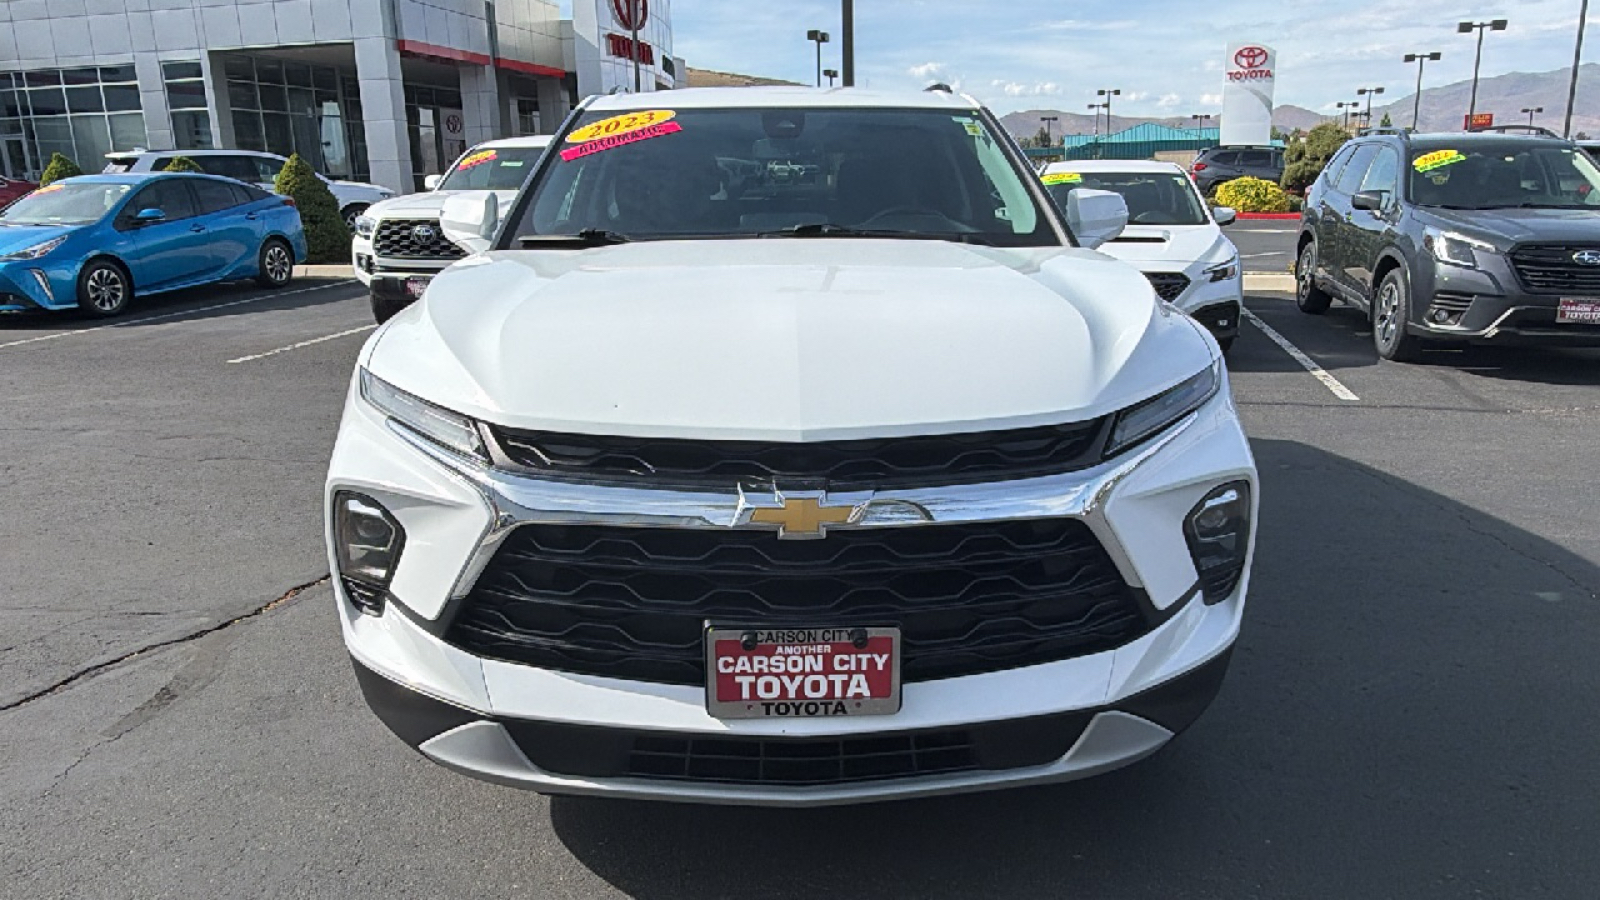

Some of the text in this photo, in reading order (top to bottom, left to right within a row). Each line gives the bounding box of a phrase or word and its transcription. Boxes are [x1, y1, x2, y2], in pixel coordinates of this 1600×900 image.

[1227, 69, 1272, 80] TOYOTA
[589, 112, 655, 138] 2023
[756, 629, 853, 643] CARSON CITY
[775, 645, 831, 655] ANOTHER
[717, 653, 890, 673] CARSON CITY
[734, 674, 871, 700] TOYOTA
[761, 701, 848, 716] TOYOTA
